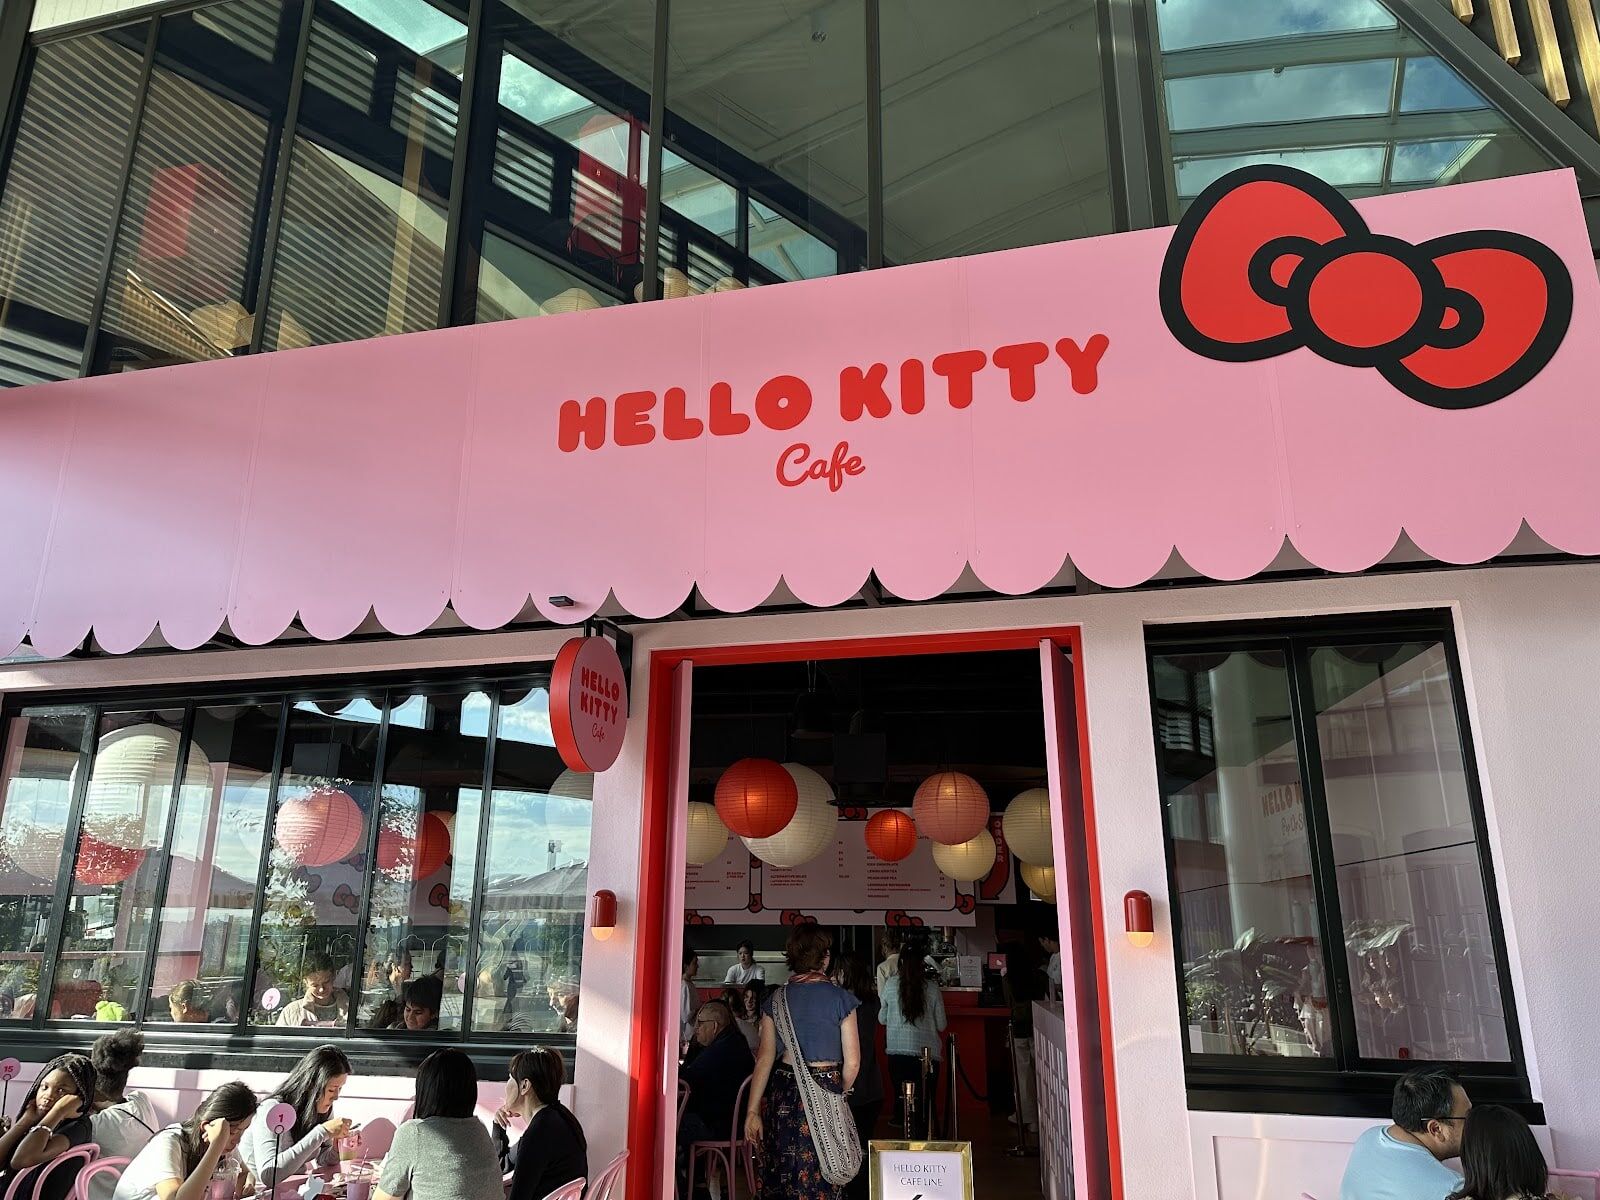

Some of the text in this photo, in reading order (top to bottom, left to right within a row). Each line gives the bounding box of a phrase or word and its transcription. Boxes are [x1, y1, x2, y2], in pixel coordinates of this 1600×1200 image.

[558, 334, 1110, 453] HELLO KITTY
[775, 441, 866, 492] Cafe
[581, 666, 620, 701] HELLO
[580, 691, 618, 725] KITTY
[592, 722, 605, 743] Cafe
[3, 1065, 14, 1073] 15
[278, 1114, 284, 1123] 1
[893, 1164, 947, 1173] HELLO KITTY
[900, 1177, 943, 1186] CAFE LINE
